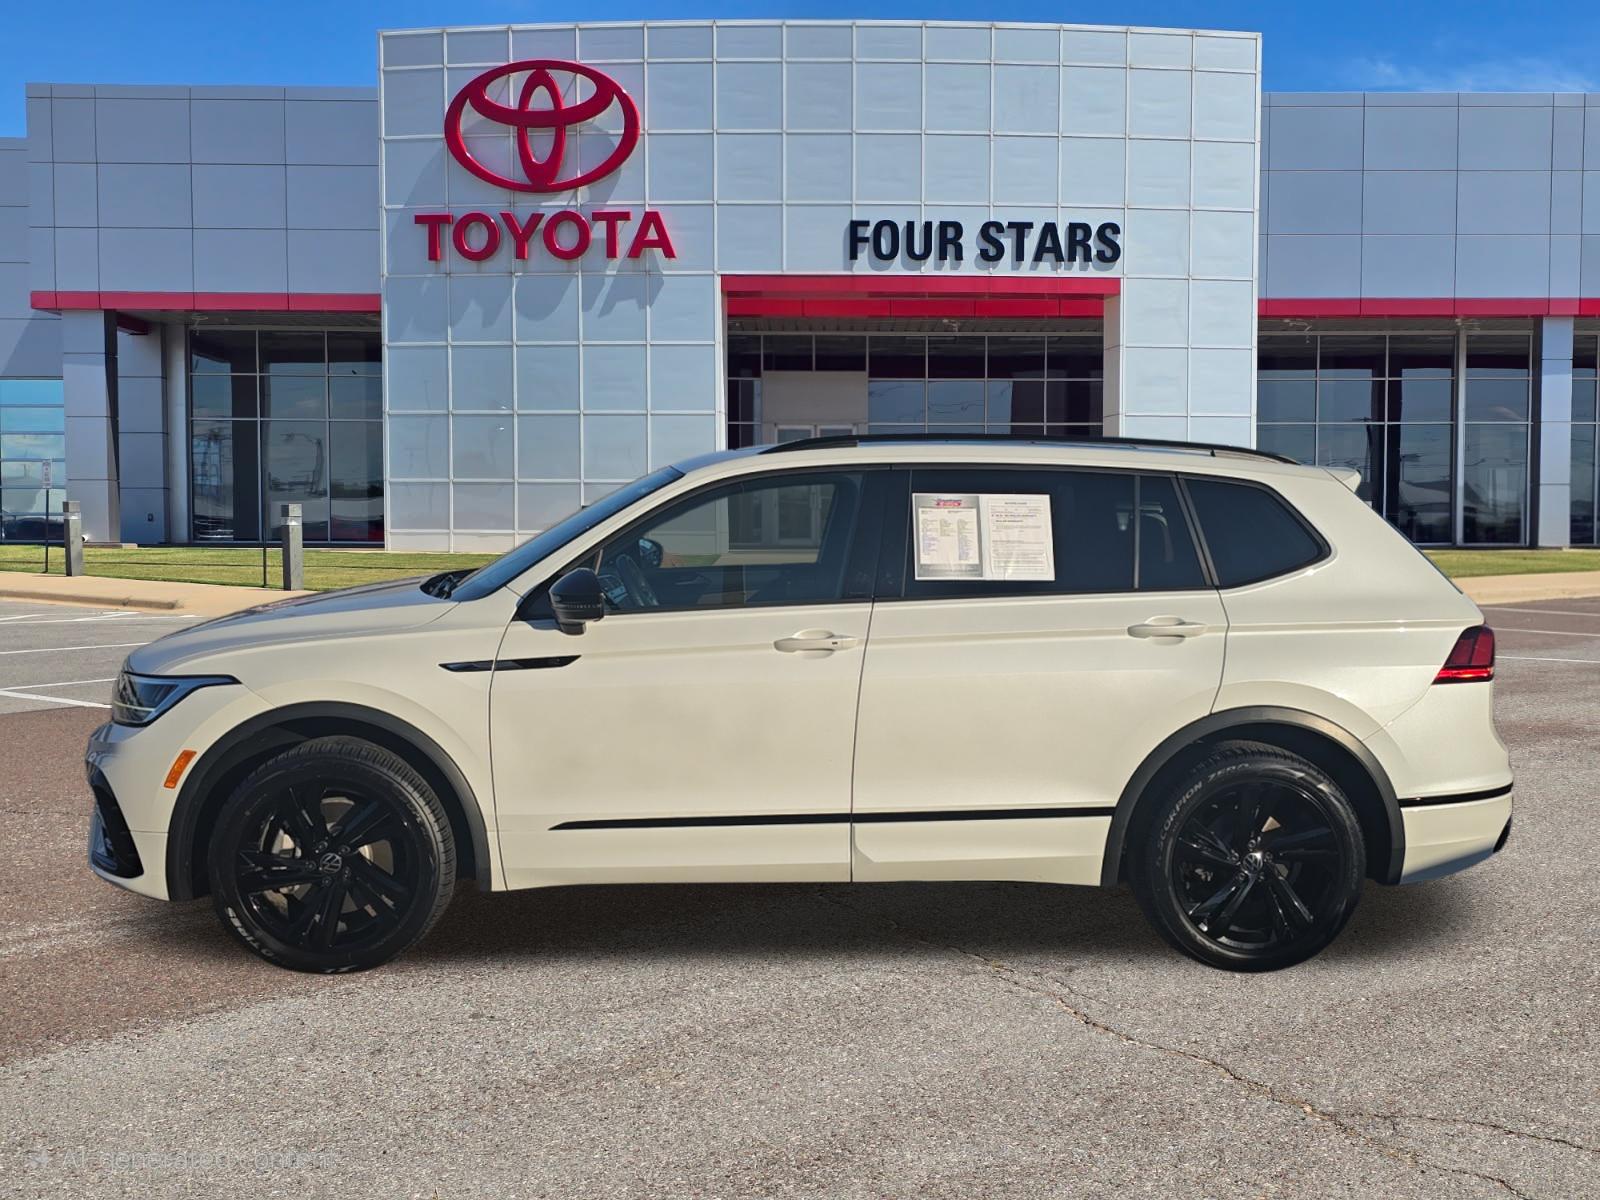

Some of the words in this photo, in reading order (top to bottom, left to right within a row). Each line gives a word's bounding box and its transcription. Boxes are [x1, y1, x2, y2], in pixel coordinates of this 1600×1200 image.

[414, 210, 677, 261] TOYOTA
[850, 219, 964, 261] FOUR
[979, 220, 1121, 263] STARS
